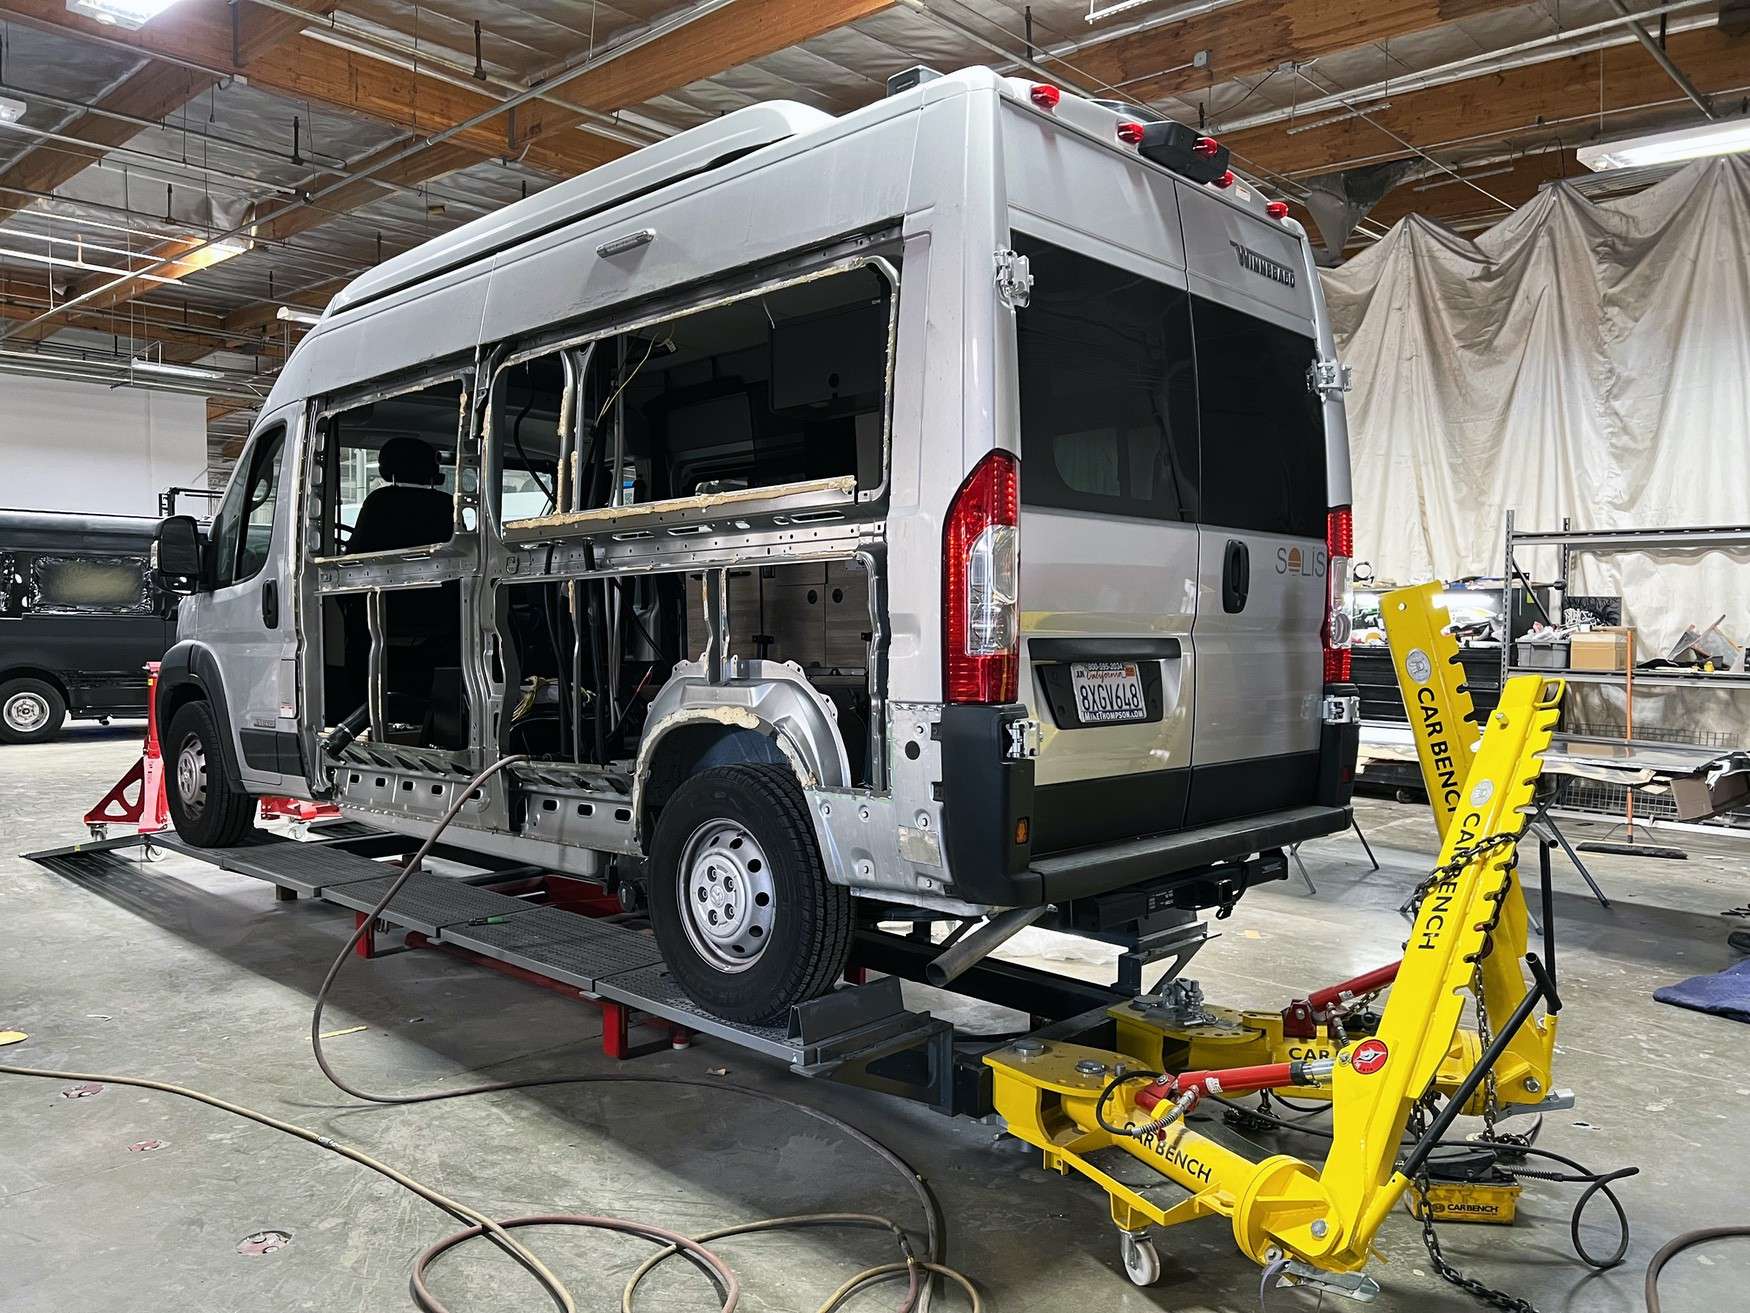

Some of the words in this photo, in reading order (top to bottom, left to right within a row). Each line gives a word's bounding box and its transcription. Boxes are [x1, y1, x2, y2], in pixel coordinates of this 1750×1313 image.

[1230, 240, 1295, 288] WINNEBAGO
[1080, 683, 1140, 711] 8XGV648
[1417, 687, 1444, 738] CAR
[1289, 1047, 1330, 1061] CAR
[1155, 1139, 1212, 1184] BENCH
